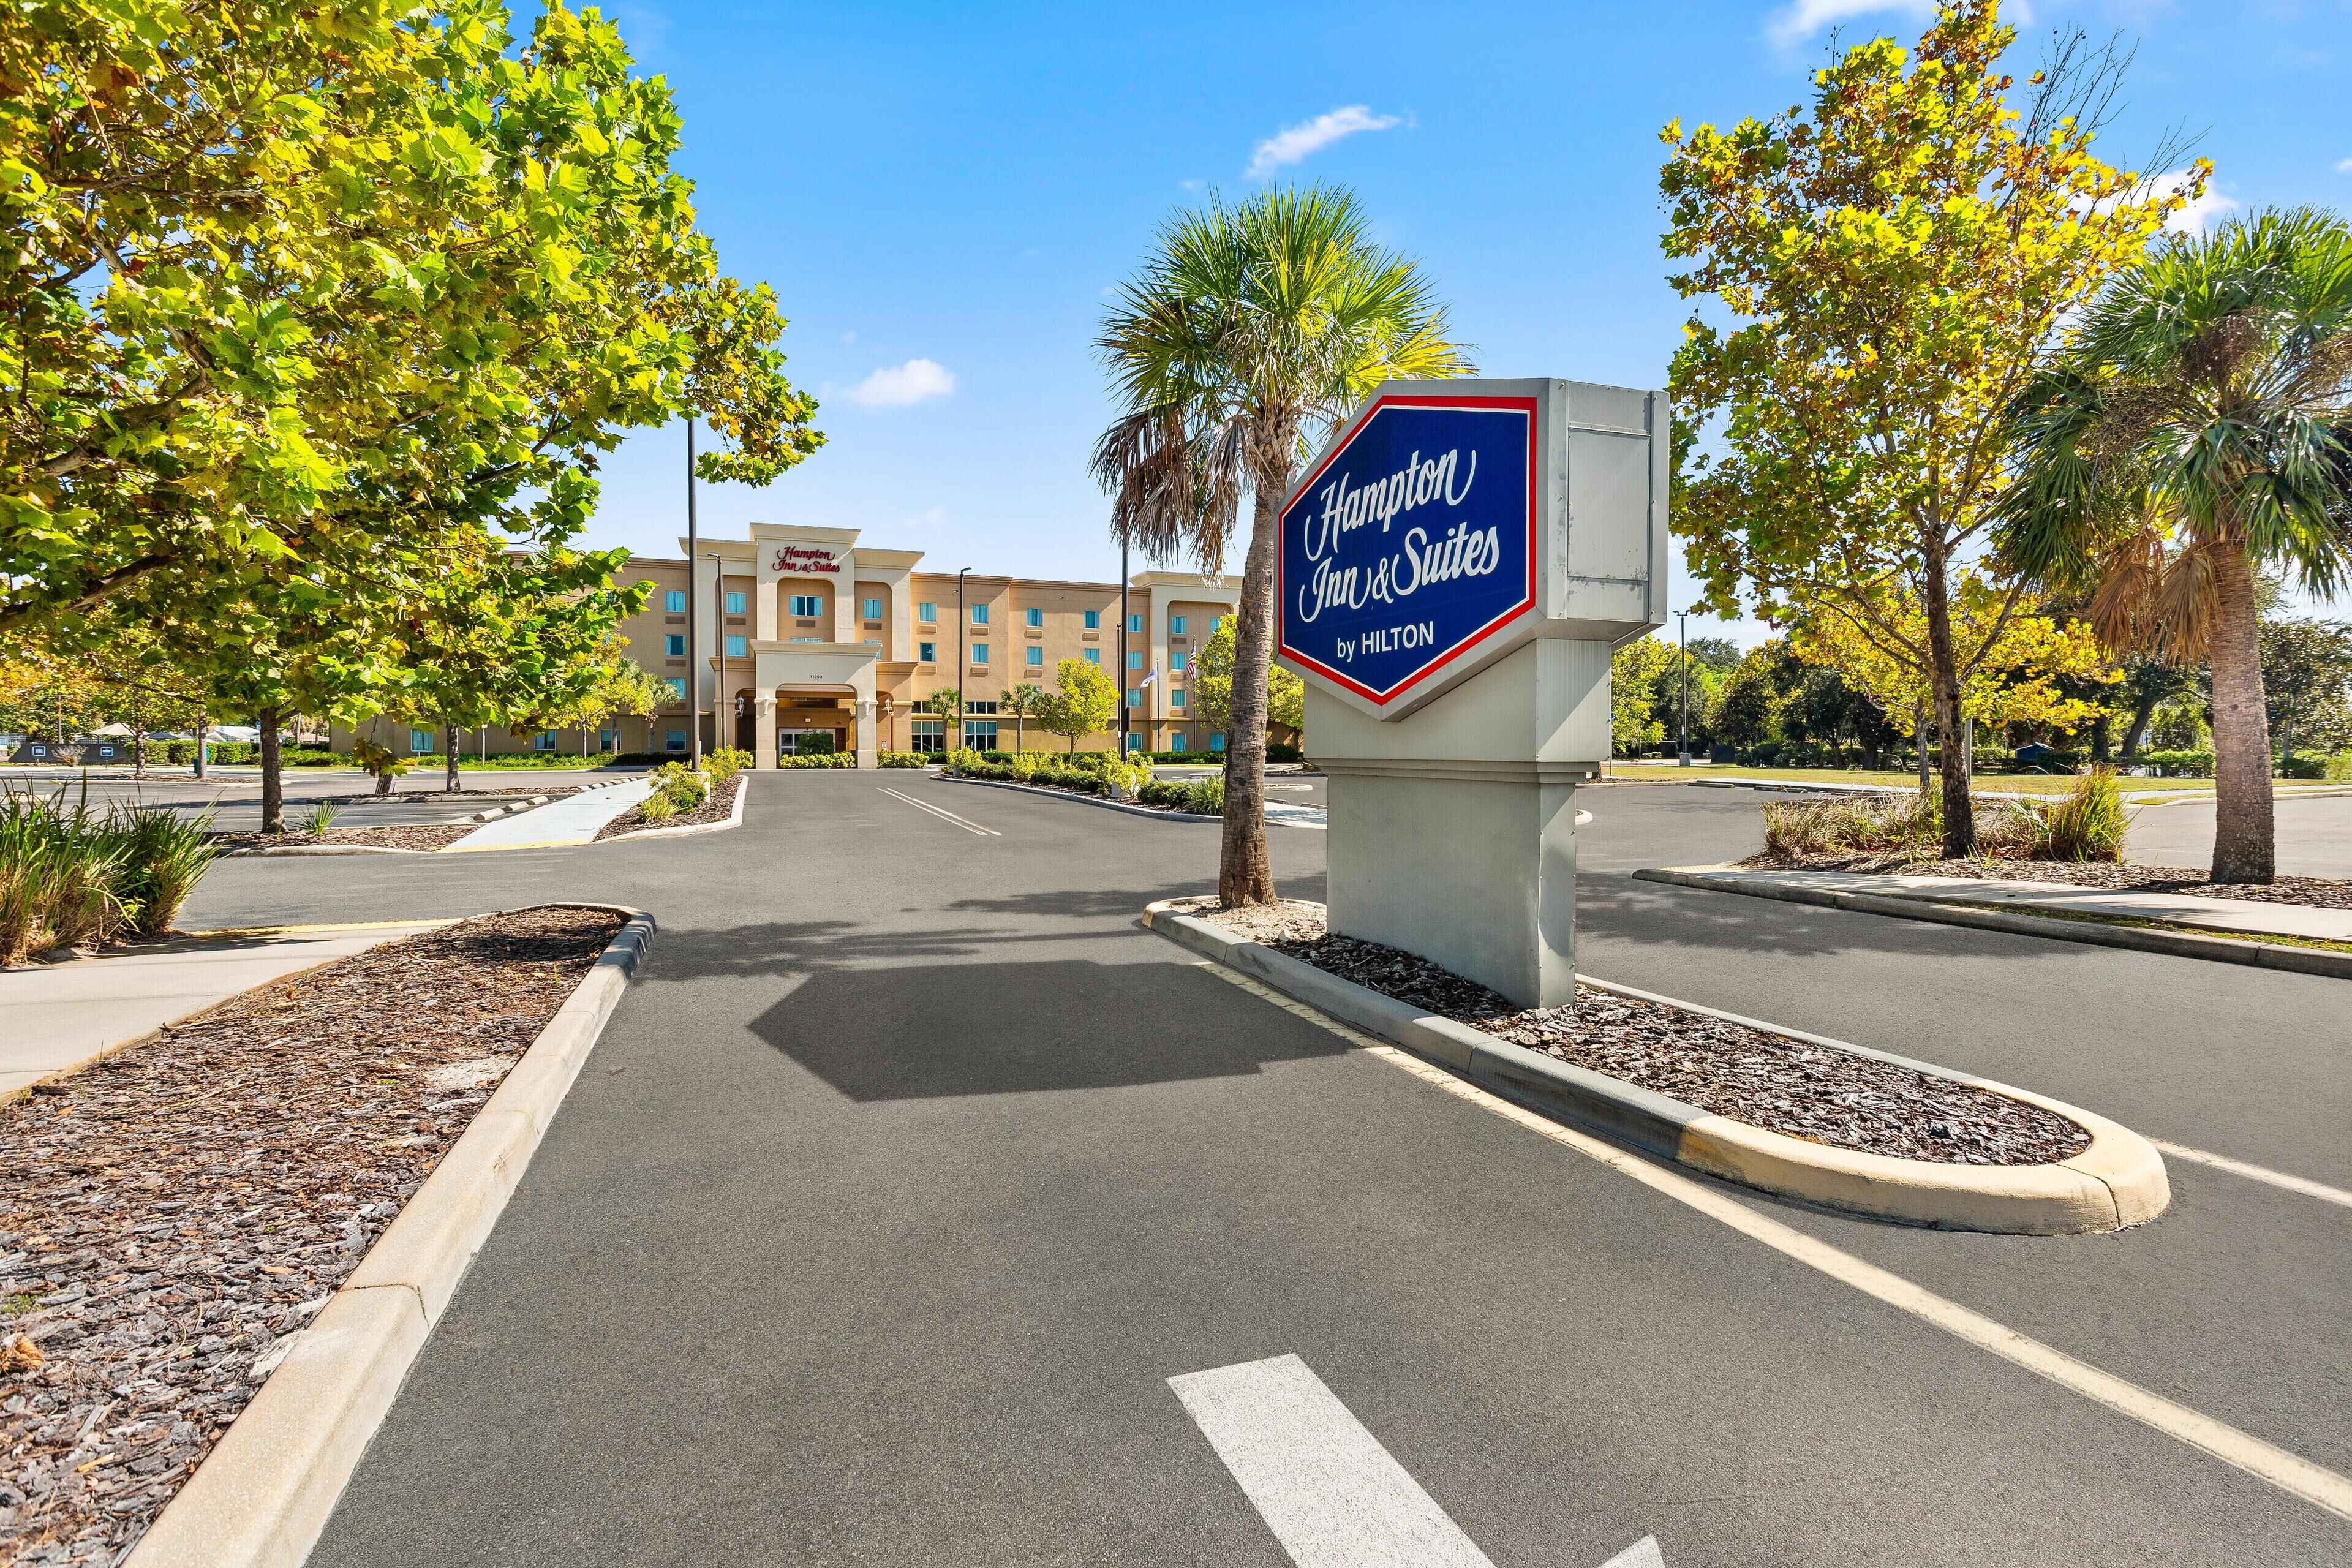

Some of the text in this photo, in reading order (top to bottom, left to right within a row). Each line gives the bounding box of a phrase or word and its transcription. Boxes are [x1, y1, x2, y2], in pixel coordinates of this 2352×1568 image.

[1305, 448, 1476, 562] Hampton
[772, 559, 840, 573] Inn & Suites
[777, 546, 835, 560] Hampton
[1298, 521, 1499, 623] Inn & Suites
[1337, 620, 1434, 663] by HILTON
